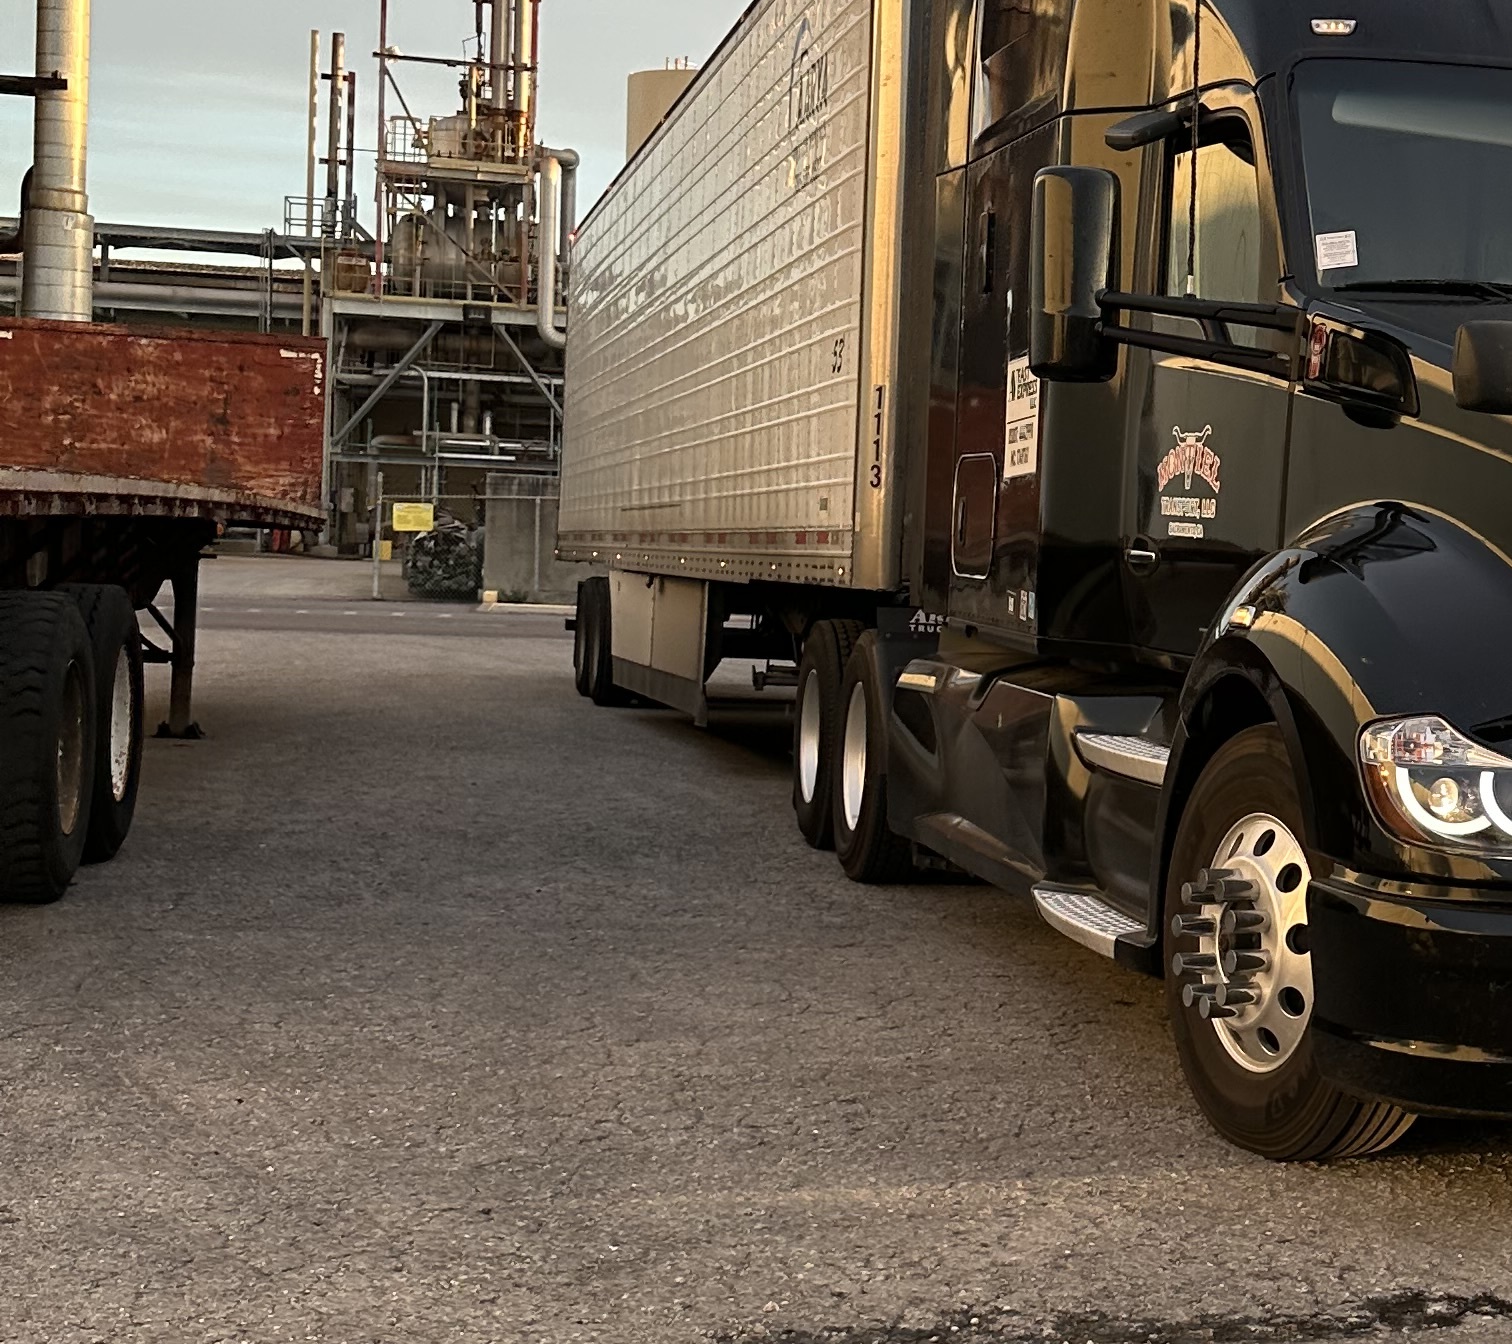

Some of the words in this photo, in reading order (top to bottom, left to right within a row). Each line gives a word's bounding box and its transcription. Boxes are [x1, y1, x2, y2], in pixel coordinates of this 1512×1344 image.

[832, 338, 845, 374] 53
[870, 385, 883, 488] 1113
[909, 625, 943, 633] TRUC
